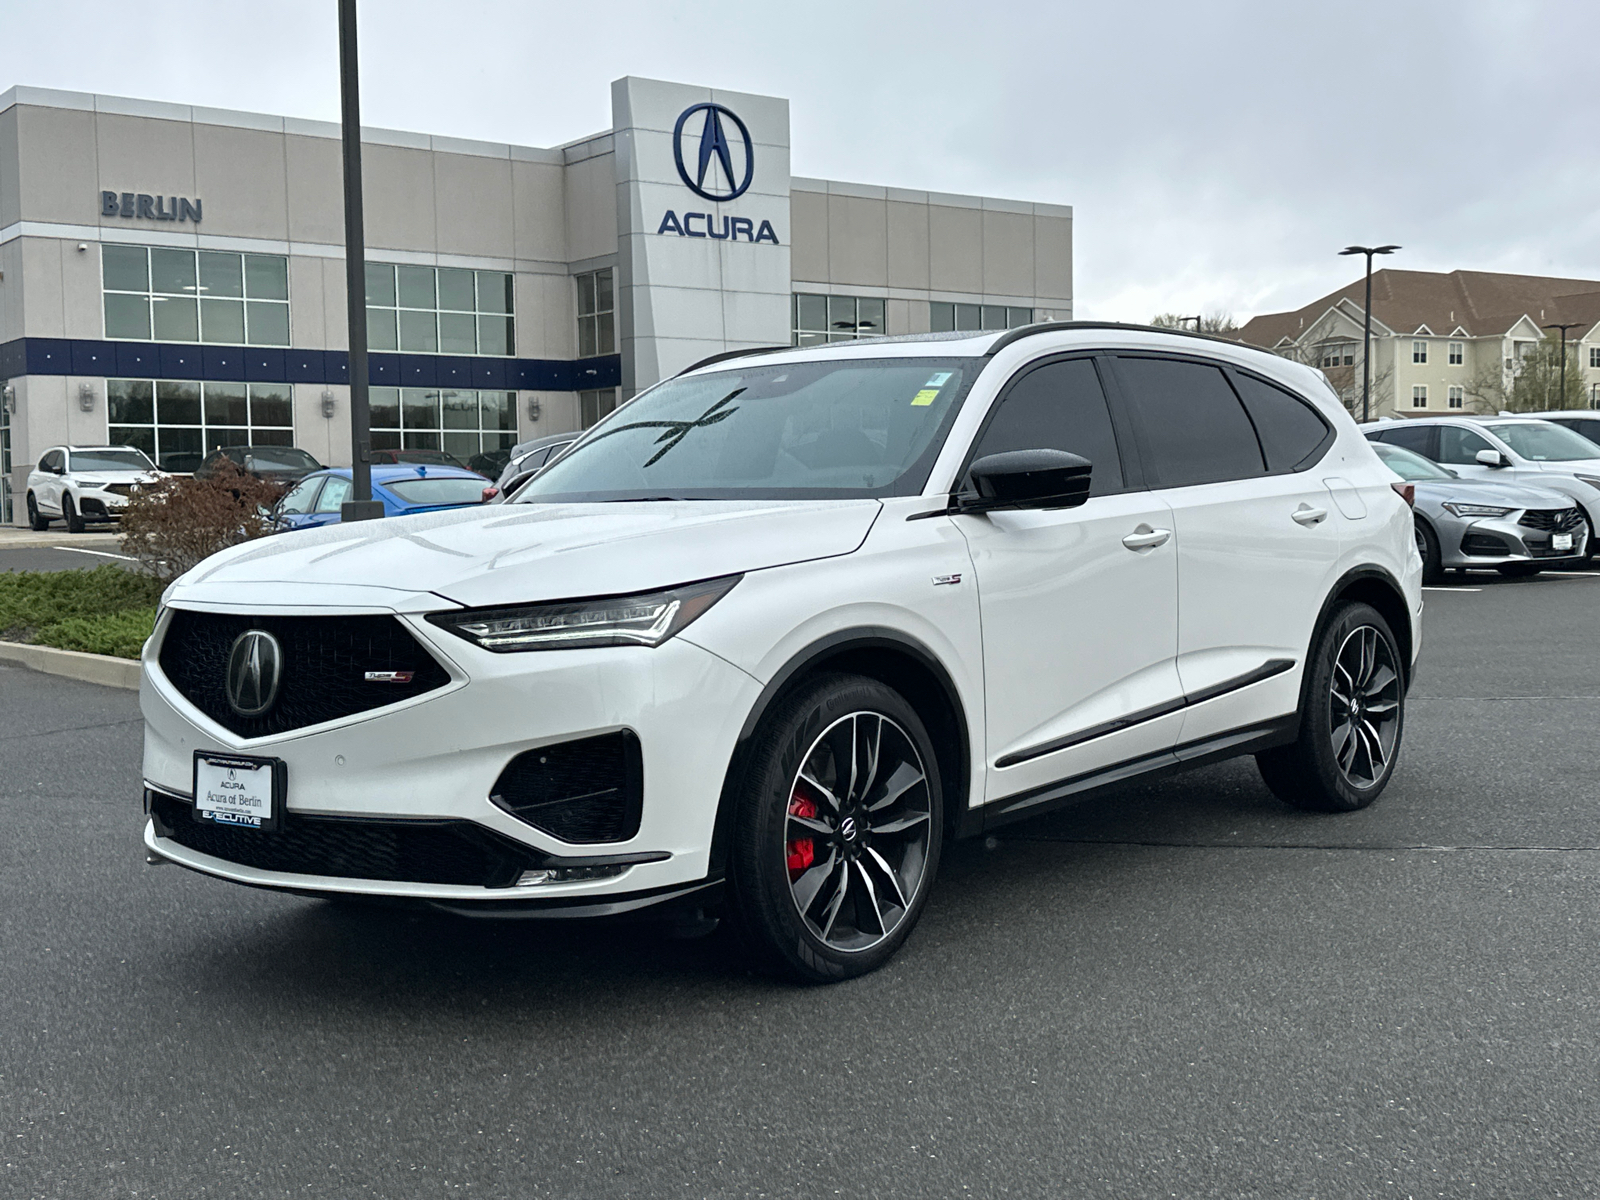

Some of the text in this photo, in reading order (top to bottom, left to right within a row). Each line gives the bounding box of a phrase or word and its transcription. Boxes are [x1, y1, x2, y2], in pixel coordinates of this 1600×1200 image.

[101, 190, 202, 223] BERLIN
[657, 210, 779, 244] ACURA
[220, 781, 245, 790] ACURA
[206, 790, 262, 807] Acura of Berlin
[202, 810, 261, 825] EXECUTIVE
